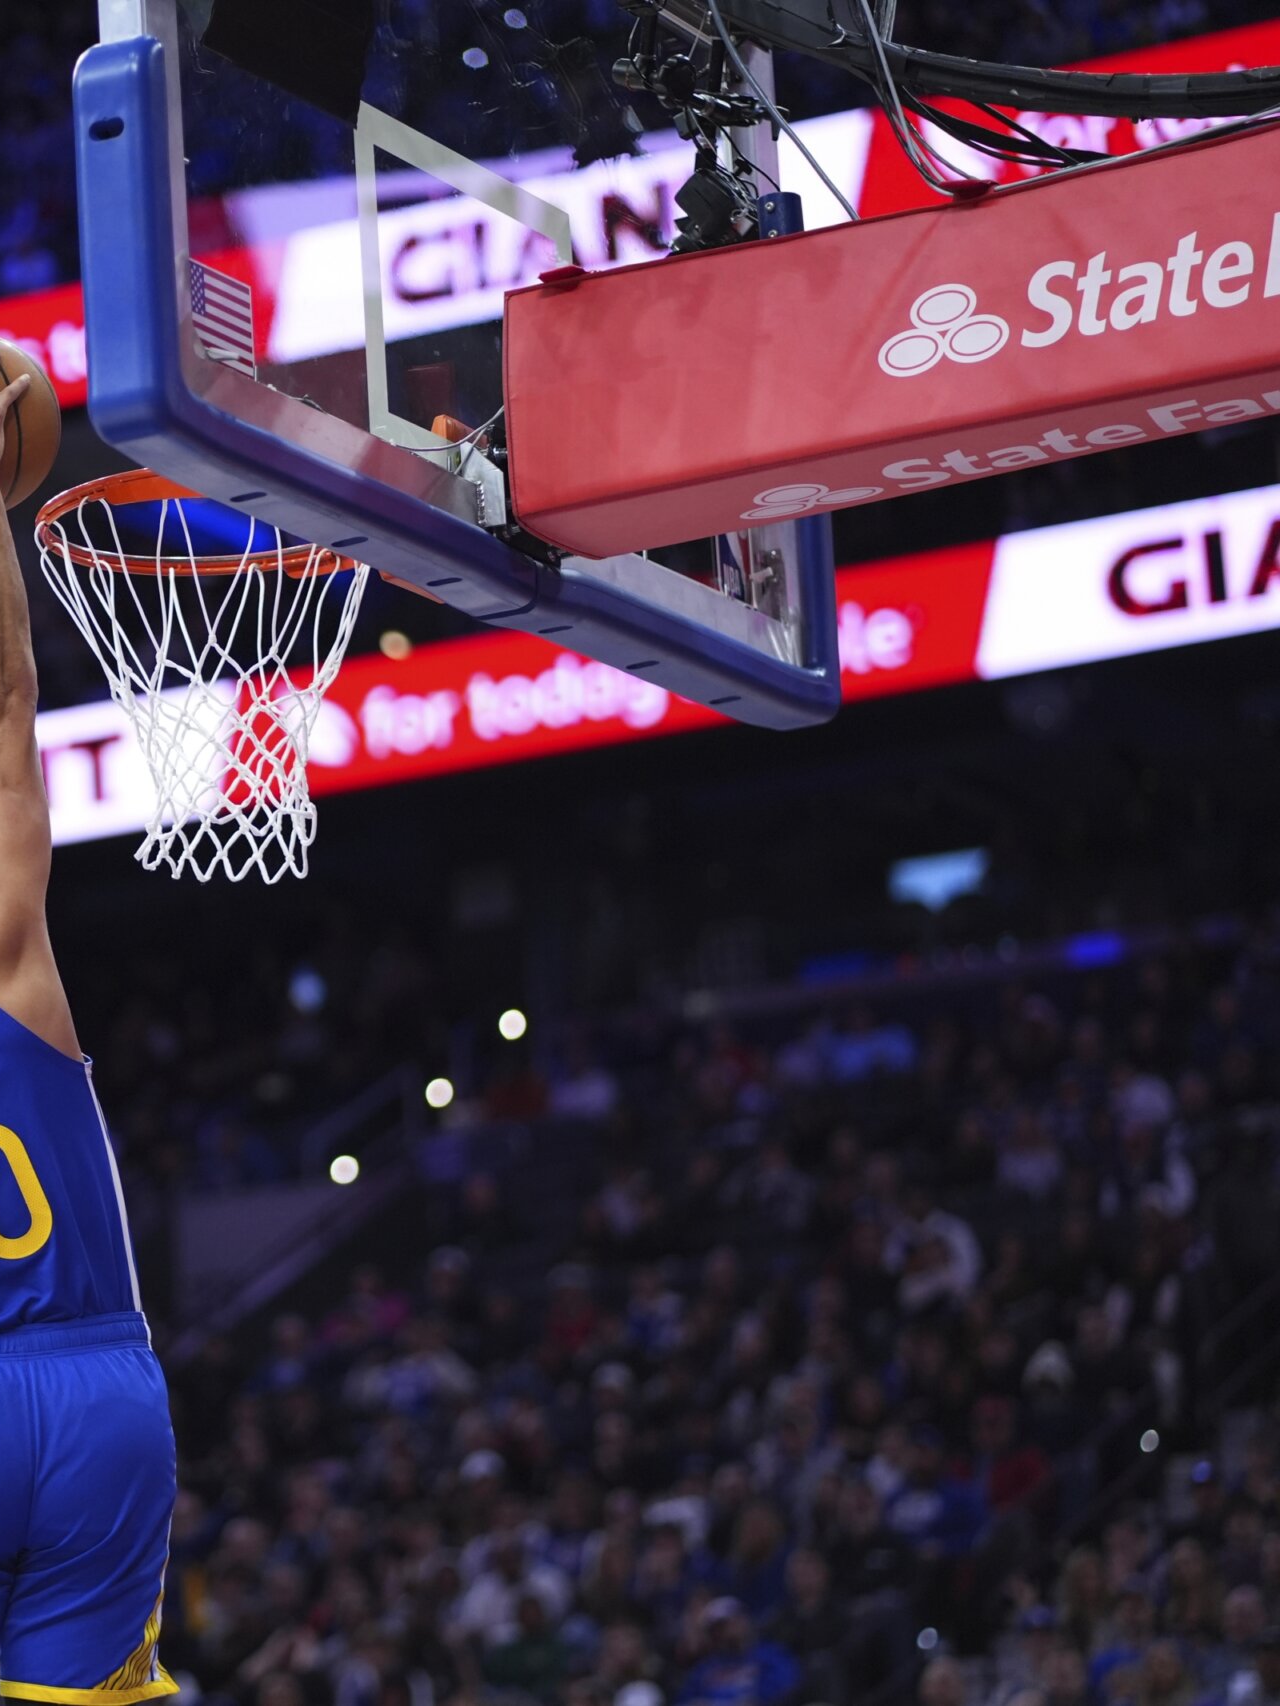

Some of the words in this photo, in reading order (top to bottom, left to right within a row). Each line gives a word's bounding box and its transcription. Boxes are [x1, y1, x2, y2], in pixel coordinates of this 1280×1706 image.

[391, 181, 668, 303] GIN
[1020, 231, 1253, 348] State
[882, 424, 1147, 488] State
[1146, 391, 1280, 433] Fa
[363, 685, 460, 759] for
[467, 652, 669, 729] today
